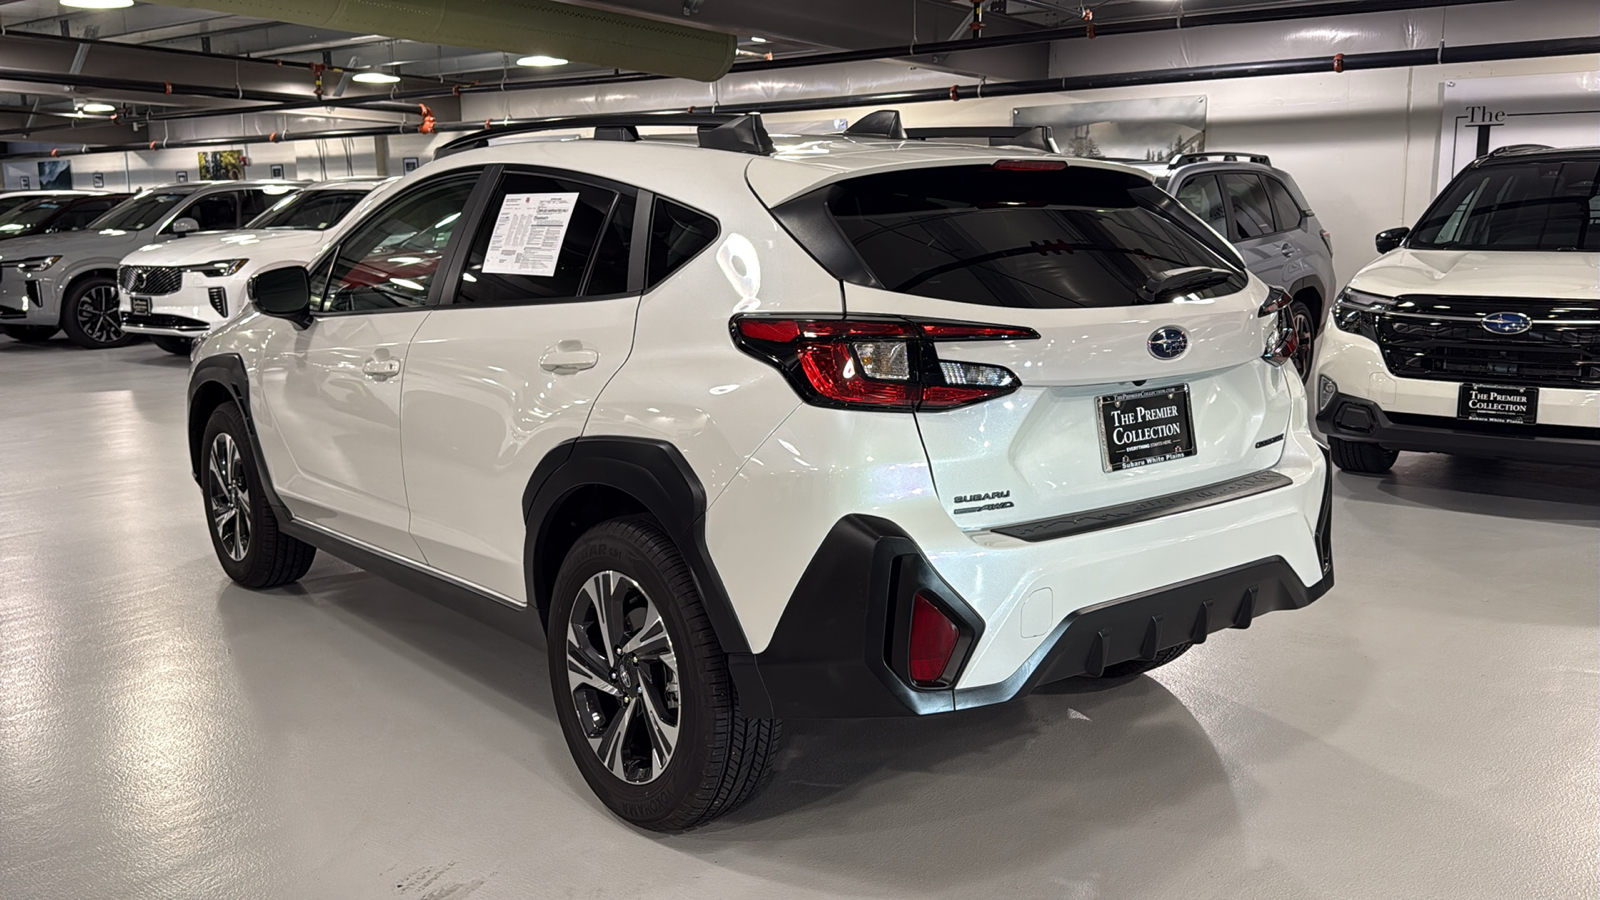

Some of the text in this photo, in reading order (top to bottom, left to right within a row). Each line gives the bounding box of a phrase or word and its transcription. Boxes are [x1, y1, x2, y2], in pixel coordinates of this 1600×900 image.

[1466, 106, 1505, 123] The
[1469, 390, 1527, 403] THE PREMIER
[1468, 400, 1527, 412] COLLECTION
[1111, 405, 1179, 427] THE PREMIER
[1113, 422, 1181, 445] COLLECTION
[1126, 443, 1150, 452] EVERYTHING
[1122, 452, 1185, 469] Subaru White Plains
[954, 490, 1010, 503] SUBARU
